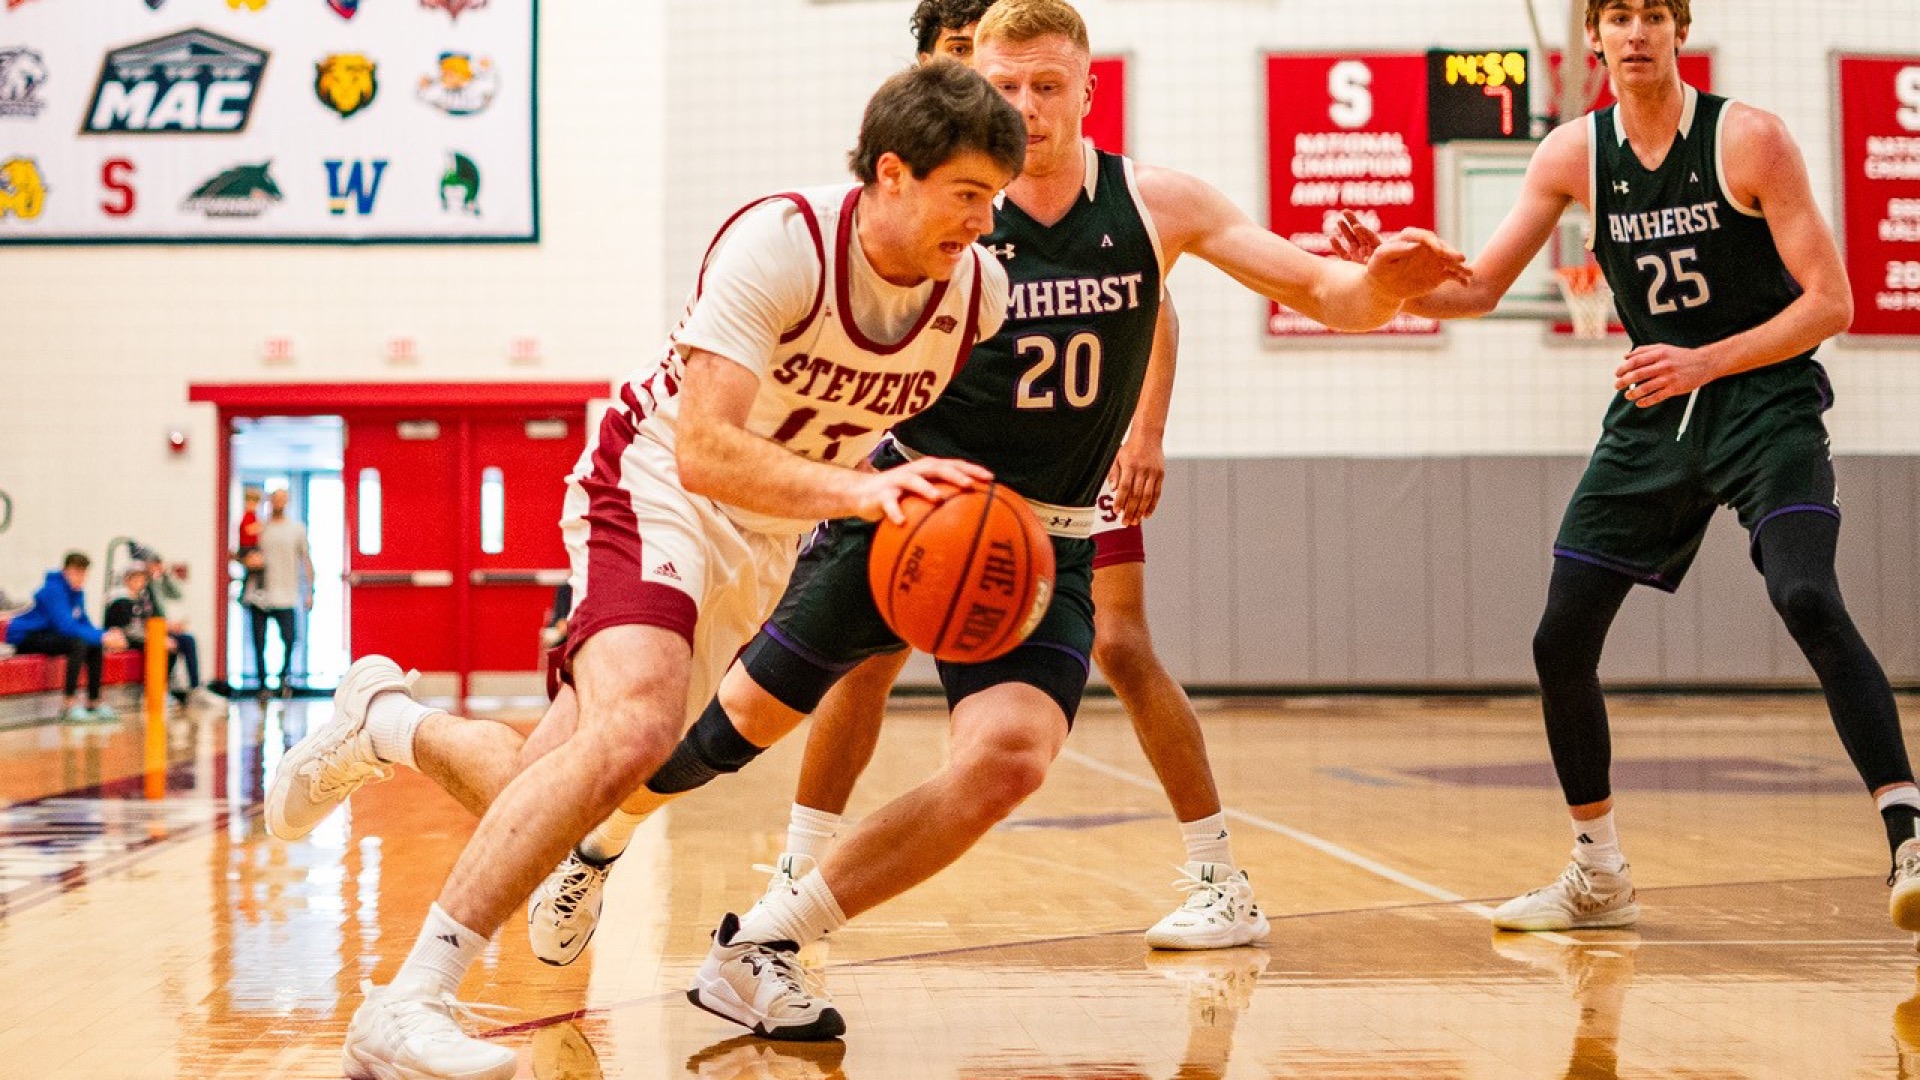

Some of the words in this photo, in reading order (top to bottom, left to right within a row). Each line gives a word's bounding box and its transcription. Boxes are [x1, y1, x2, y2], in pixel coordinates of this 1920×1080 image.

[91, 80, 253, 131] MAC
[1327, 59, 1372, 129] S
[101, 158, 137, 217] S
[324, 160, 389, 214] W
[1101, 233, 1114, 247] A
[1607, 201, 1721, 243] AMHERST
[1004, 272, 1143, 320] MHERST
[1635, 248, 1711, 316] 25
[773, 353, 937, 416] STEVENS
[1015, 332, 1101, 409] 20
[980, 539, 1016, 597] THE
